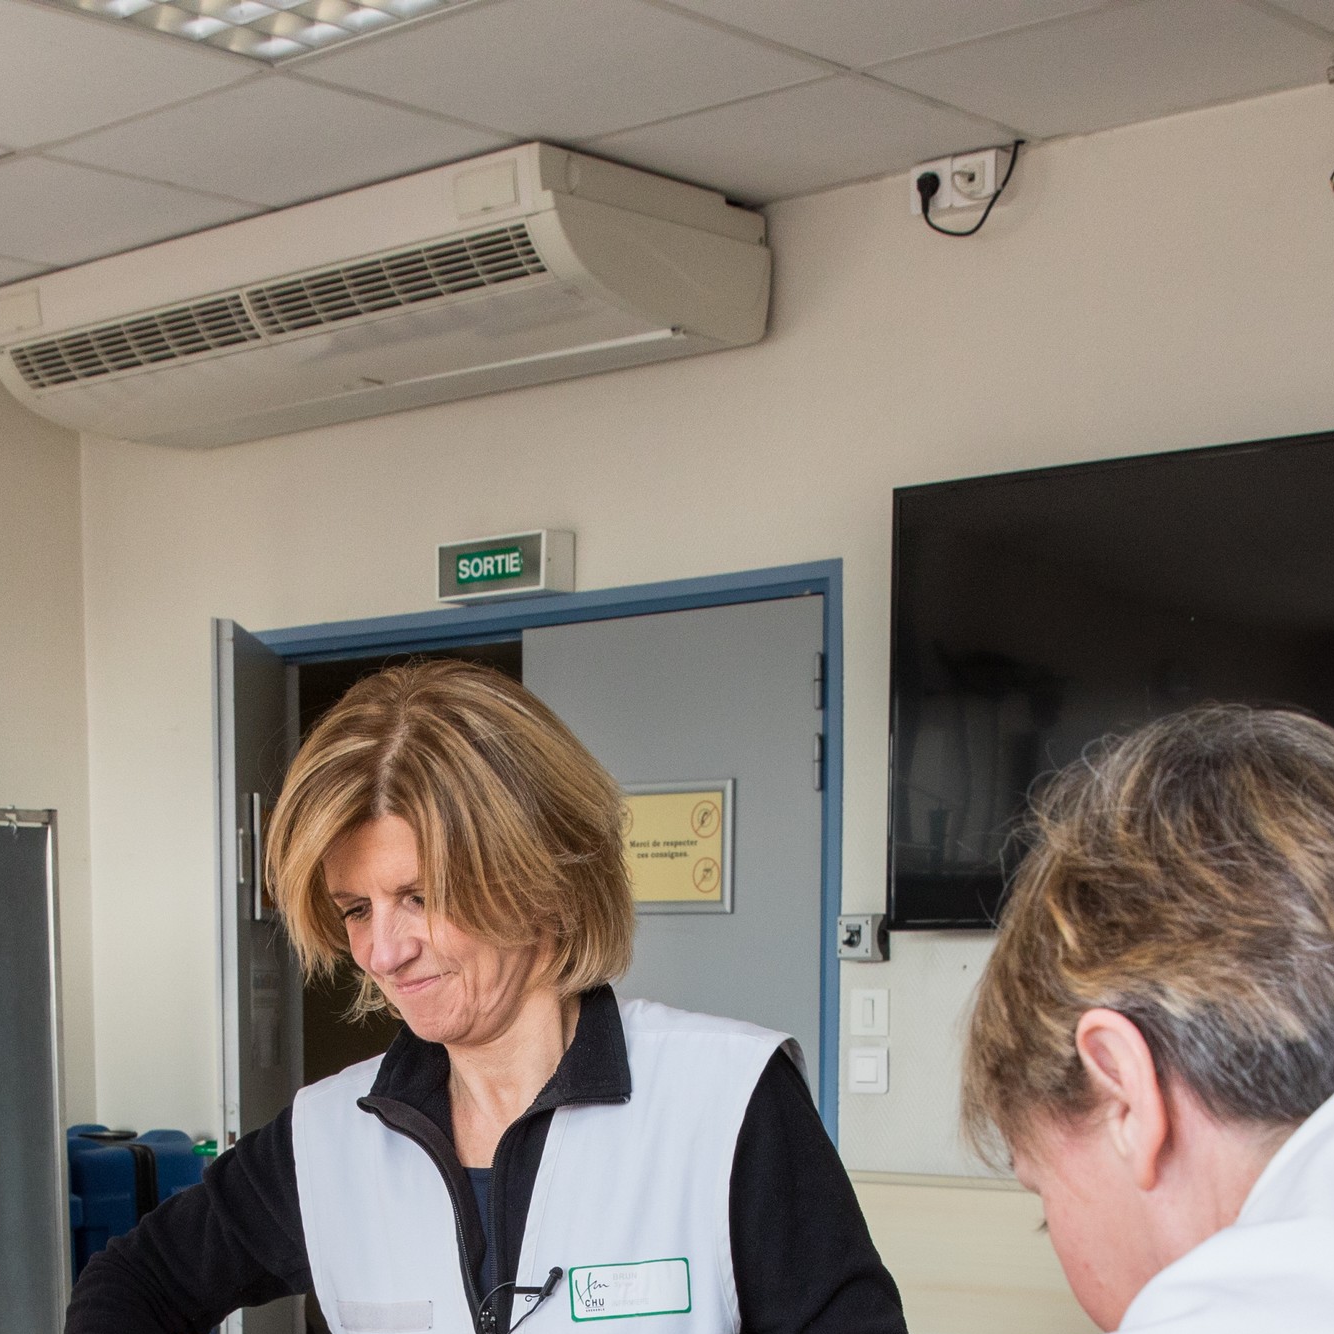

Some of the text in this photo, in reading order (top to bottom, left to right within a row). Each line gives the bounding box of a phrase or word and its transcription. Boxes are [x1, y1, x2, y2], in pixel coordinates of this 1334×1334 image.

[458, 552, 521, 579] SORTIE
[630, 840, 649, 848] Merci
[663, 839, 698, 848] respecter
[585, 1298, 605, 1308] CHU
